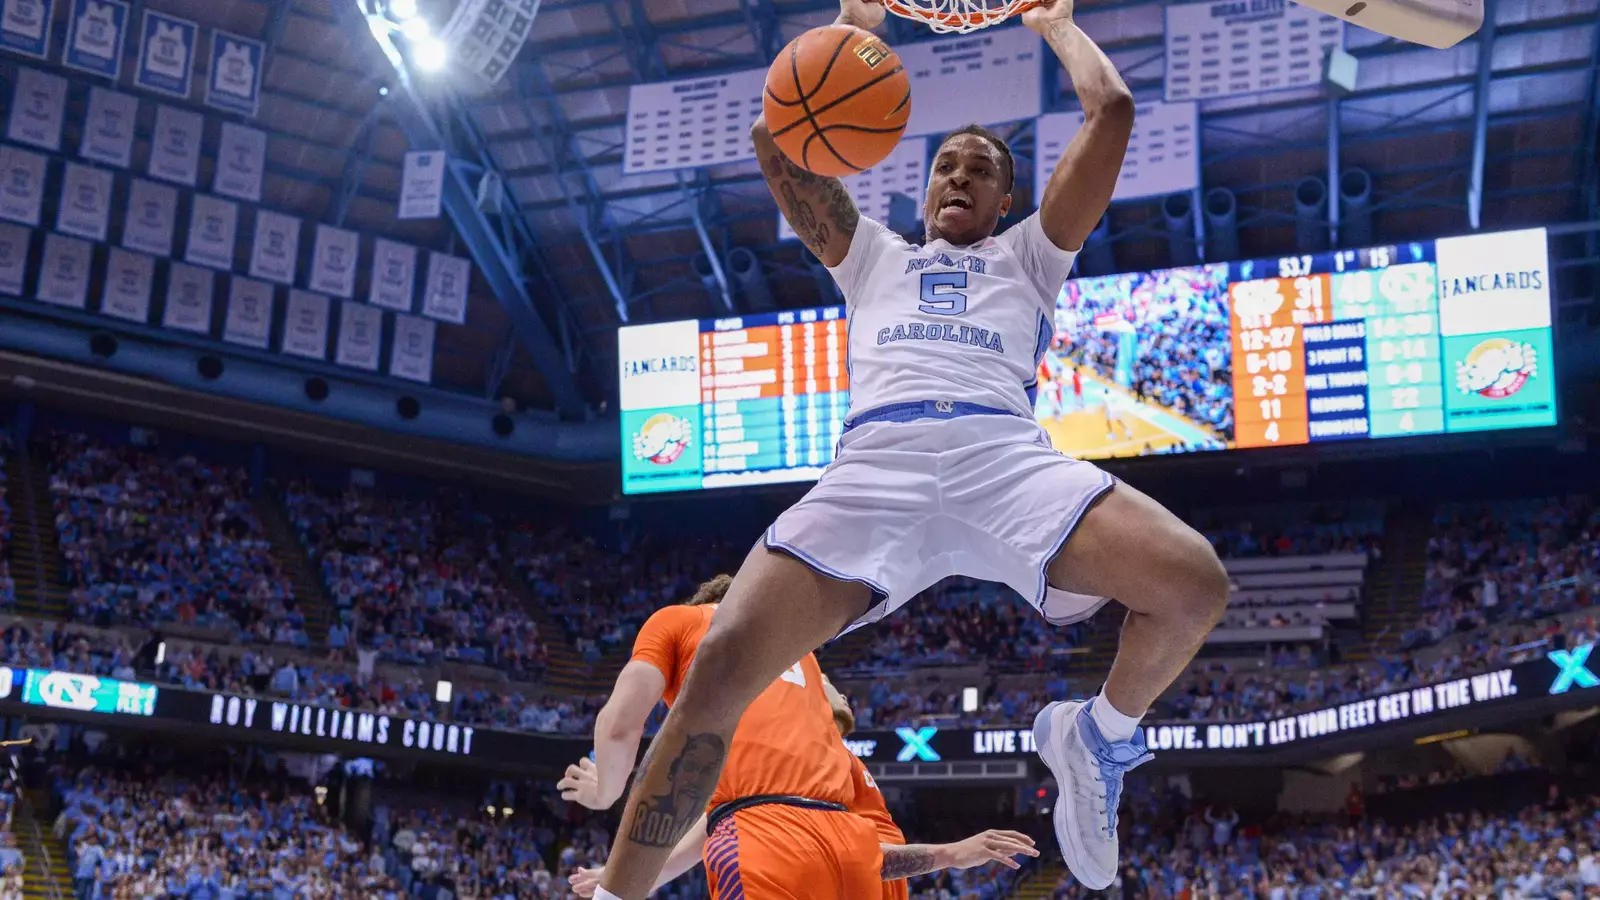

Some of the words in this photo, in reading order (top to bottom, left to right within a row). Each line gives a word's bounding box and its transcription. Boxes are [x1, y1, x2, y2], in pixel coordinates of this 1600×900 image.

[1369, 247, 1390, 268] 15
[918, 271, 967, 316] 5
[1294, 275, 1323, 310] 31
[1442, 270, 1542, 298] FANCARDS
[877, 323, 1004, 353] CAROLINA
[624, 356, 697, 379] FANCARDS
[1260, 398, 1281, 420] 11
[1264, 421, 1280, 442] 4
[210, 694, 257, 728] ROY
[271, 701, 390, 744] WILLIAMS
[402, 719, 474, 754] COURT
[973, 730, 1016, 753] LIVE
[1146, 725, 1203, 750] LOVE.
[1207, 722, 1266, 749] DON'T
[1269, 716, 1297, 745] LET
[1297, 708, 1339, 739] YOUR
[1339, 699, 1377, 730] FEET
[1378, 691, 1411, 722] GET
[1412, 686, 1434, 715] IN
[1434, 678, 1470, 710] THE
[1471, 668, 1518, 701] WAY.
